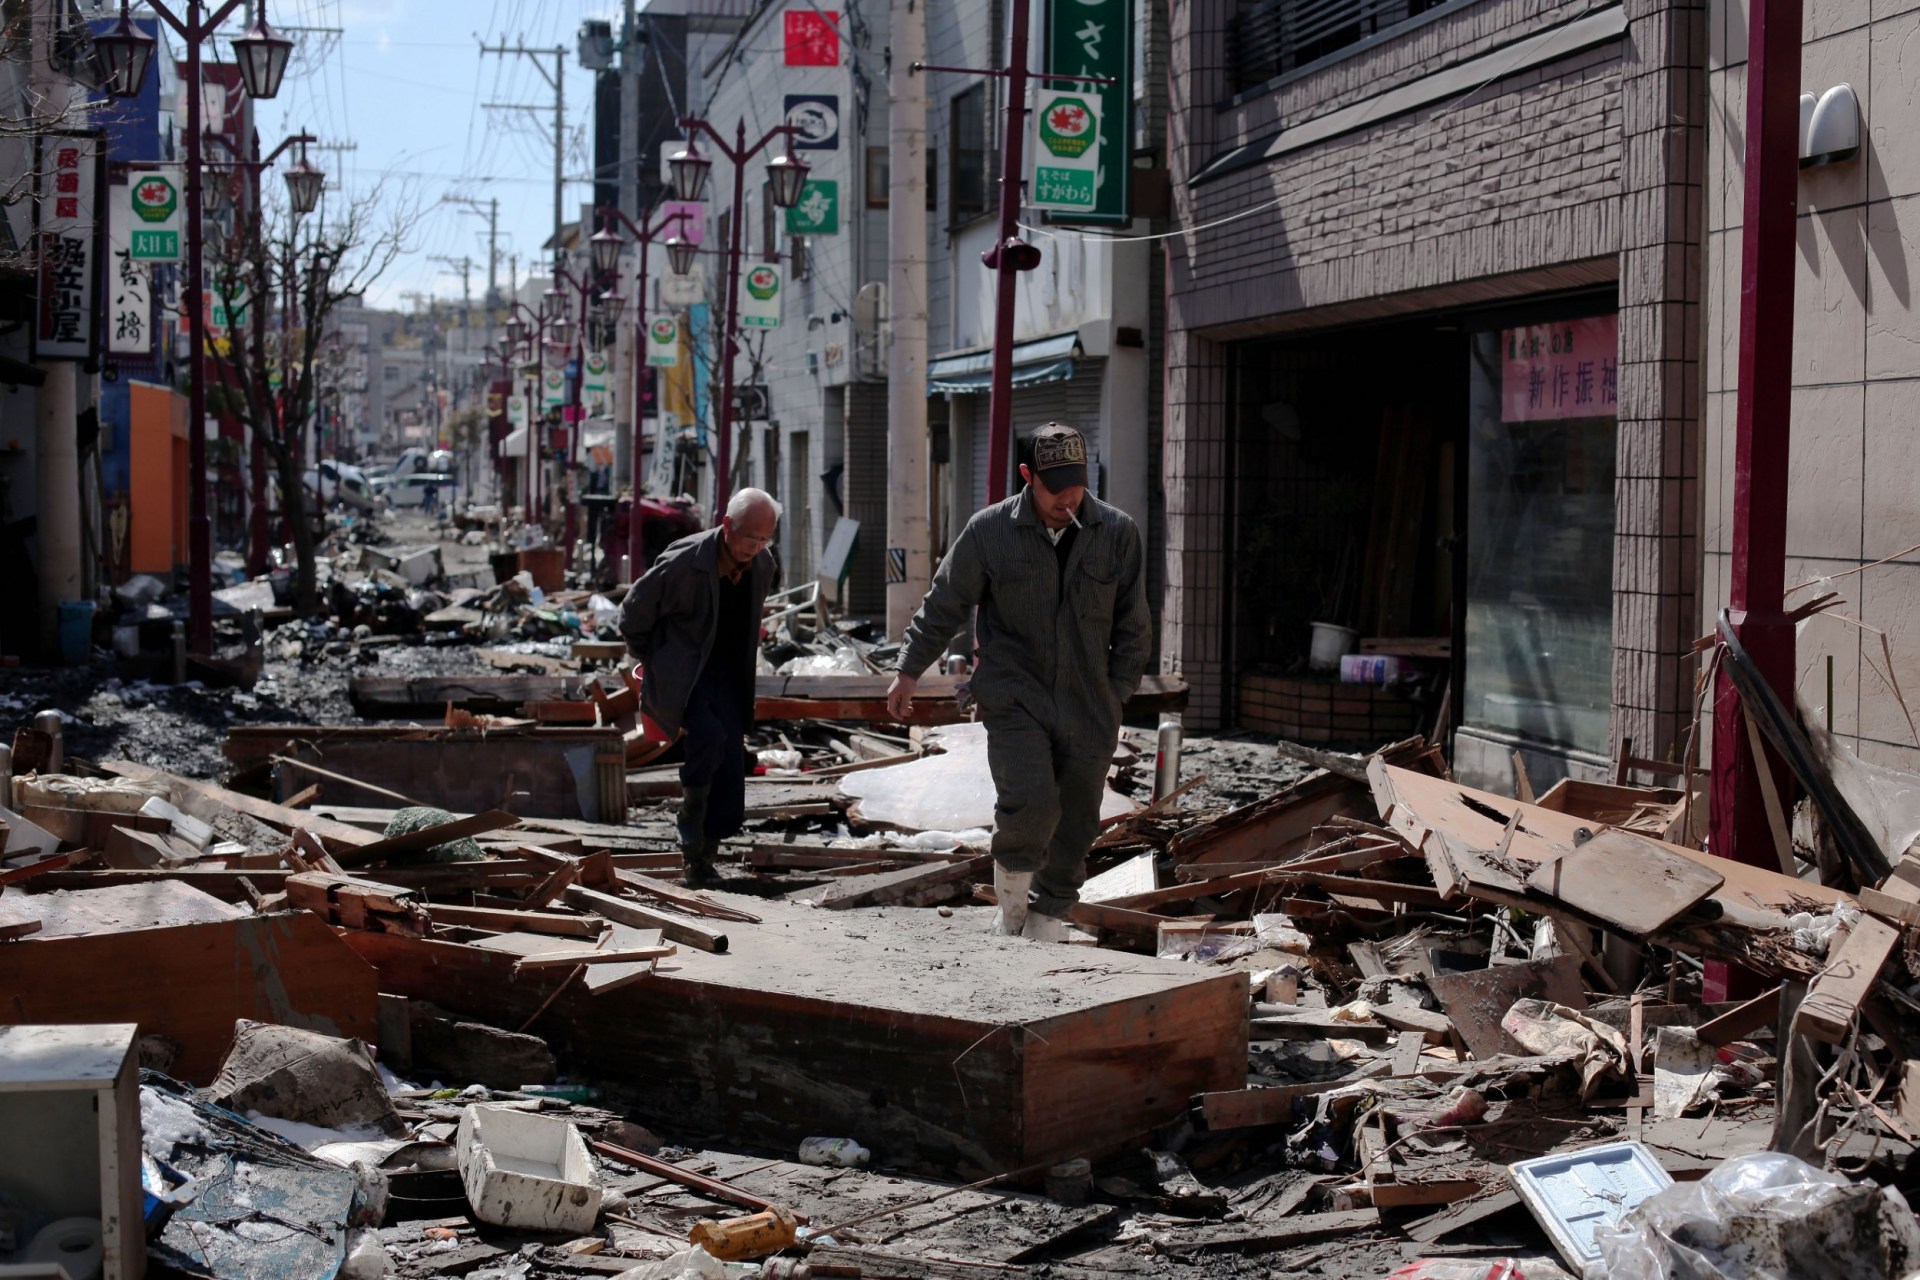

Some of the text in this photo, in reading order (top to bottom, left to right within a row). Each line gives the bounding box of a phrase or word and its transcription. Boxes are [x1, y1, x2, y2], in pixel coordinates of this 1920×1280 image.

[55, 147, 79, 218] 居酒屋
[1039, 182, 1091, 203] すがわら
